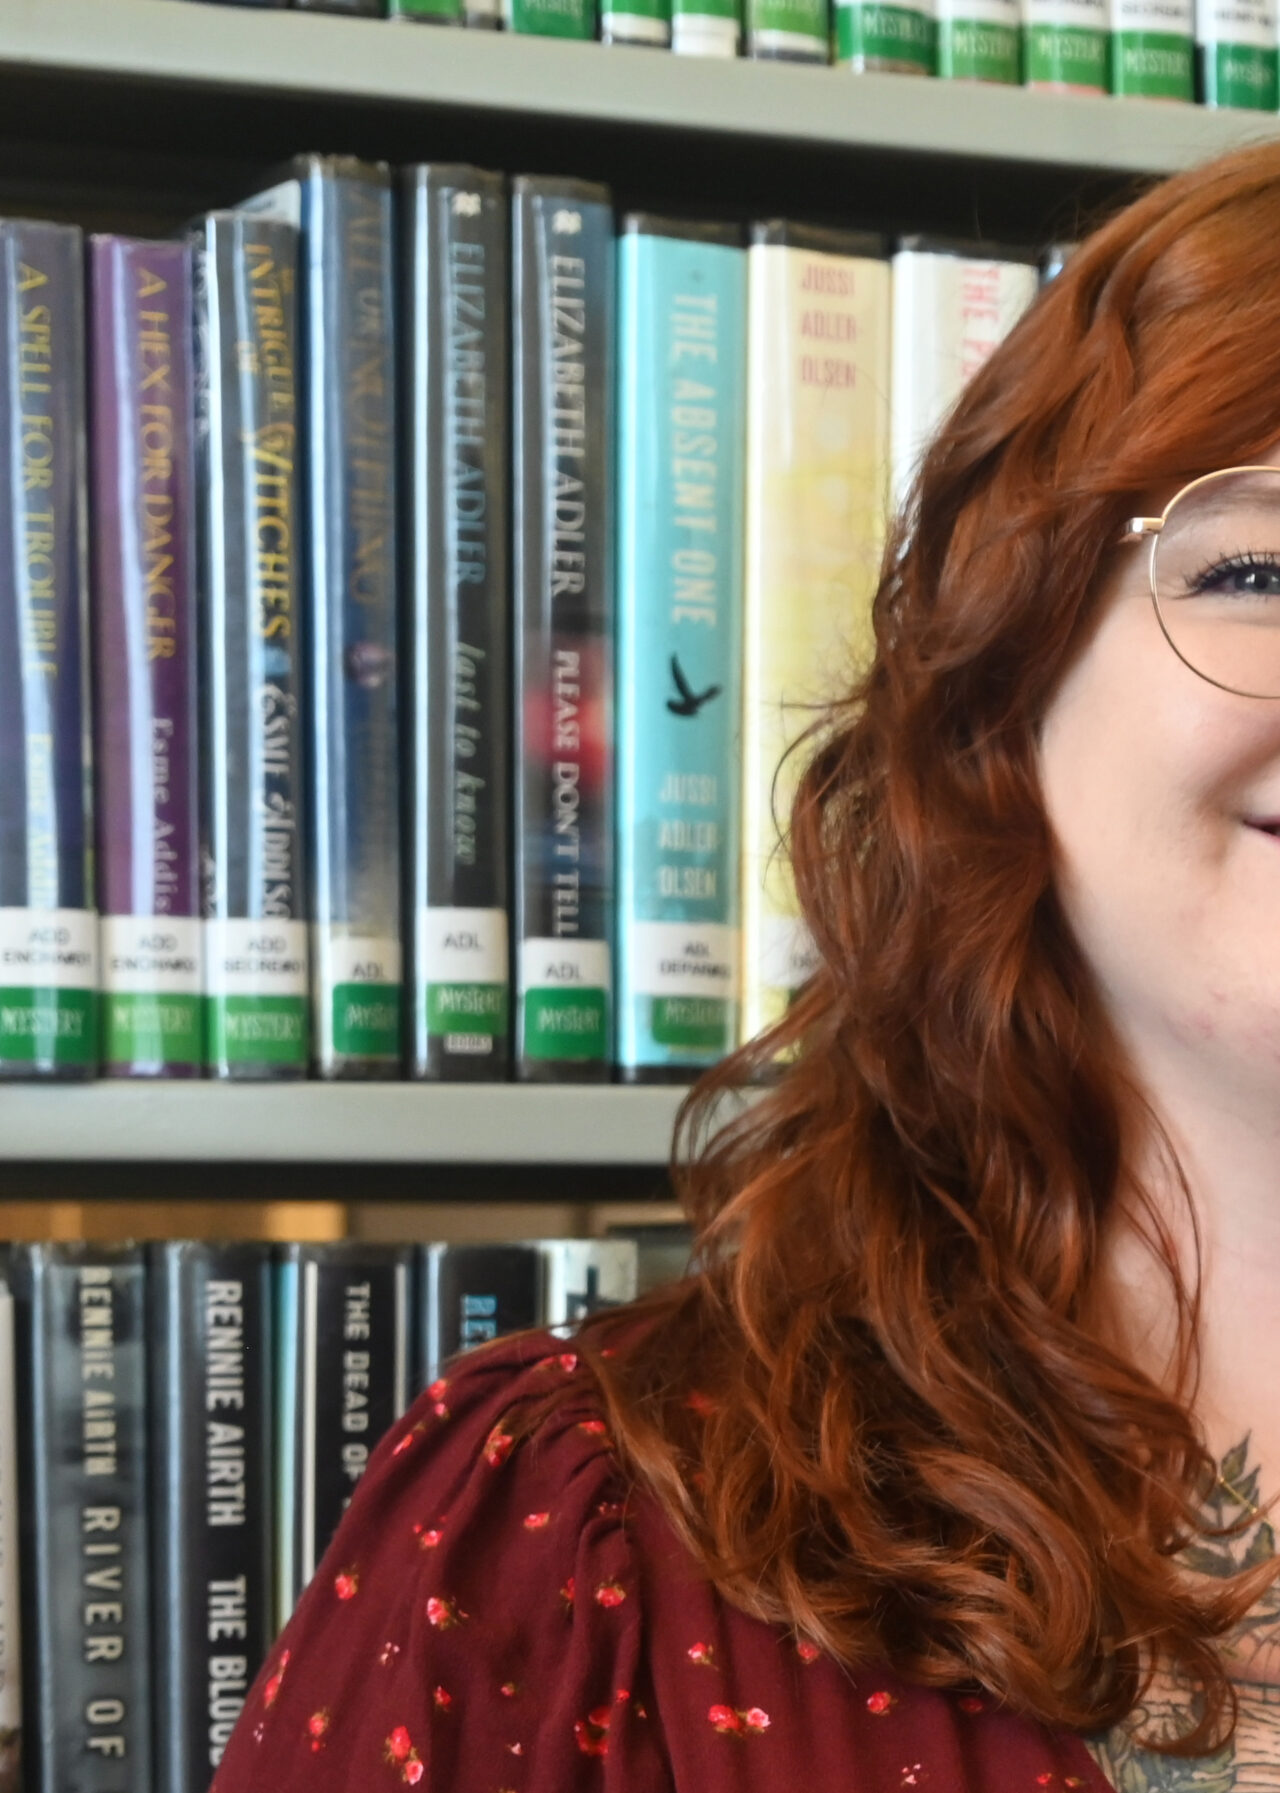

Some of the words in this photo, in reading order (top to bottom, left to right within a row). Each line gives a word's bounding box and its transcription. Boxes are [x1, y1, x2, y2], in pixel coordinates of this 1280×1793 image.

[17, 261, 49, 293] A
[136, 266, 168, 299] A
[801, 263, 856, 297] JUSSI
[959, 266, 1001, 321] THE
[18, 304, 52, 400] SPELL
[139, 310, 171, 393] HEX
[452, 241, 486, 448] ELIZABETH
[551, 254, 586, 459] ELIZABETH
[670, 293, 718, 365] THE
[801, 354, 857, 391] OLSEN
[21, 413, 54, 491] FOR
[140, 404, 173, 482] FOR
[670, 383, 718, 535] ABSENT
[453, 465, 487, 585] ADLER
[550, 471, 586, 598] ADLER
[23, 509, 58, 678] TROUBLE
[141, 493, 177, 662] DANGER
[671, 550, 718, 628] ONE
[554, 649, 580, 752] PLEASE
[659, 772, 718, 805] JUSSI
[554, 870, 580, 936] TELL
[658, 865, 718, 899] OLSEN
[443, 930, 482, 949] ADL
[546, 962, 582, 979] ADL
[206, 1279, 244, 1411] RENNIE
[345, 1281, 371, 1341] THE
[343, 1350, 370, 1434] DEAD
[207, 1421, 246, 1527] AIRTH
[83, 1505, 123, 1663] RIVER
[208, 1574, 247, 1642] THE
[86, 1699, 125, 1759] OF
